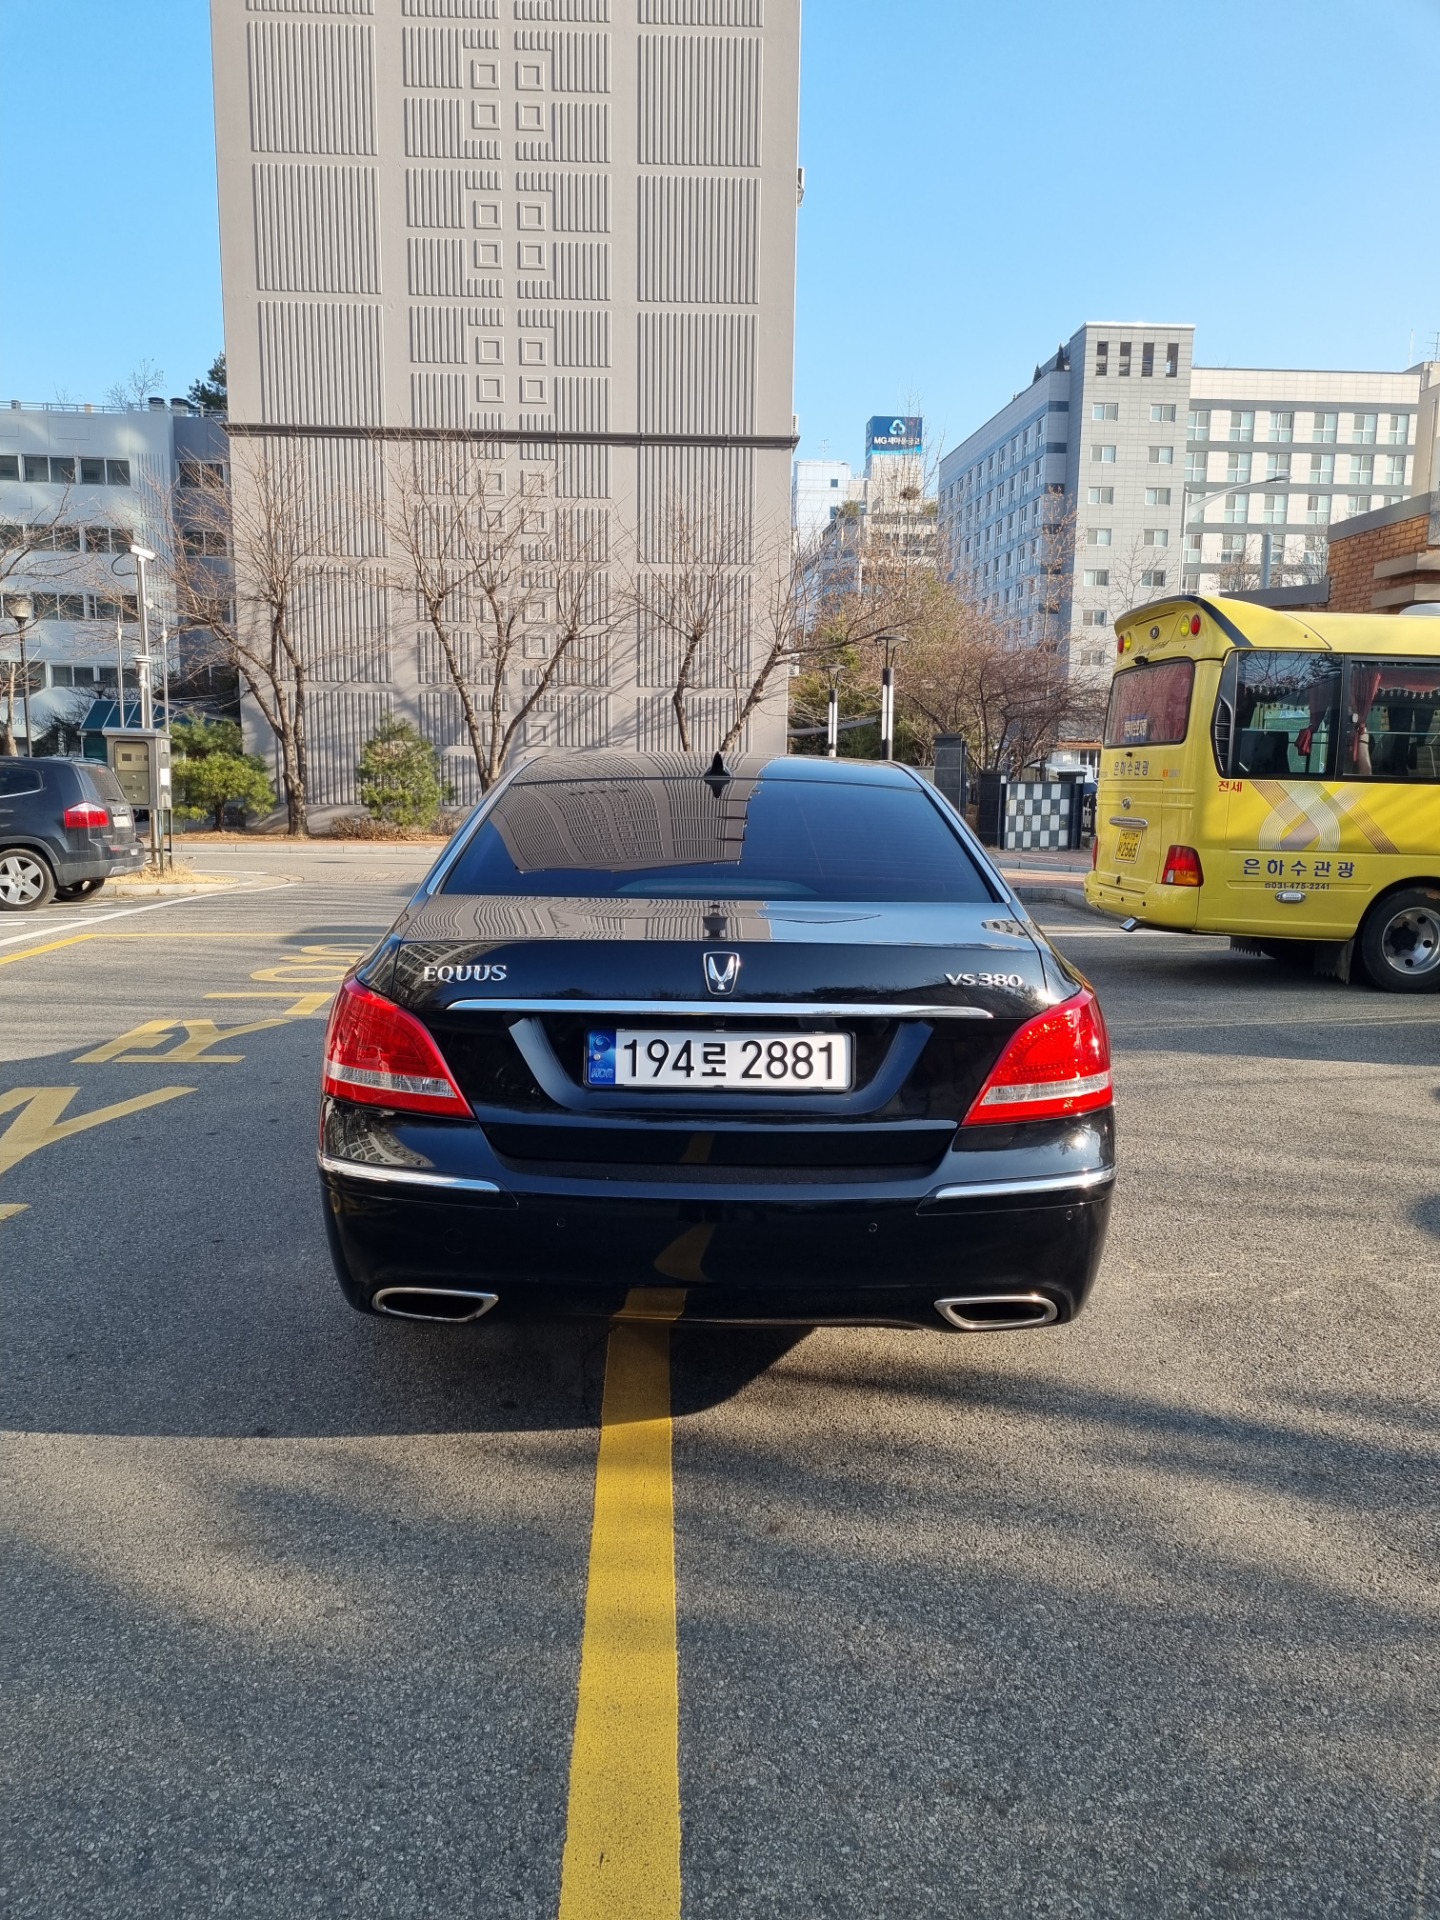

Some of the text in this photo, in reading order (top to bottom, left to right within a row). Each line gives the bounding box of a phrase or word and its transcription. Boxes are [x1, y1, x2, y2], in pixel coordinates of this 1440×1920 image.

[1113, 761, 1150, 776] 은하수관광
[1218, 780, 1243, 793] 전세
[1243, 858, 1355, 878] 은하수관광
[422, 963, 508, 984] EQUUS
[943, 972, 1024, 988] VS380
[623, 1039, 833, 1080] 194로 2881
